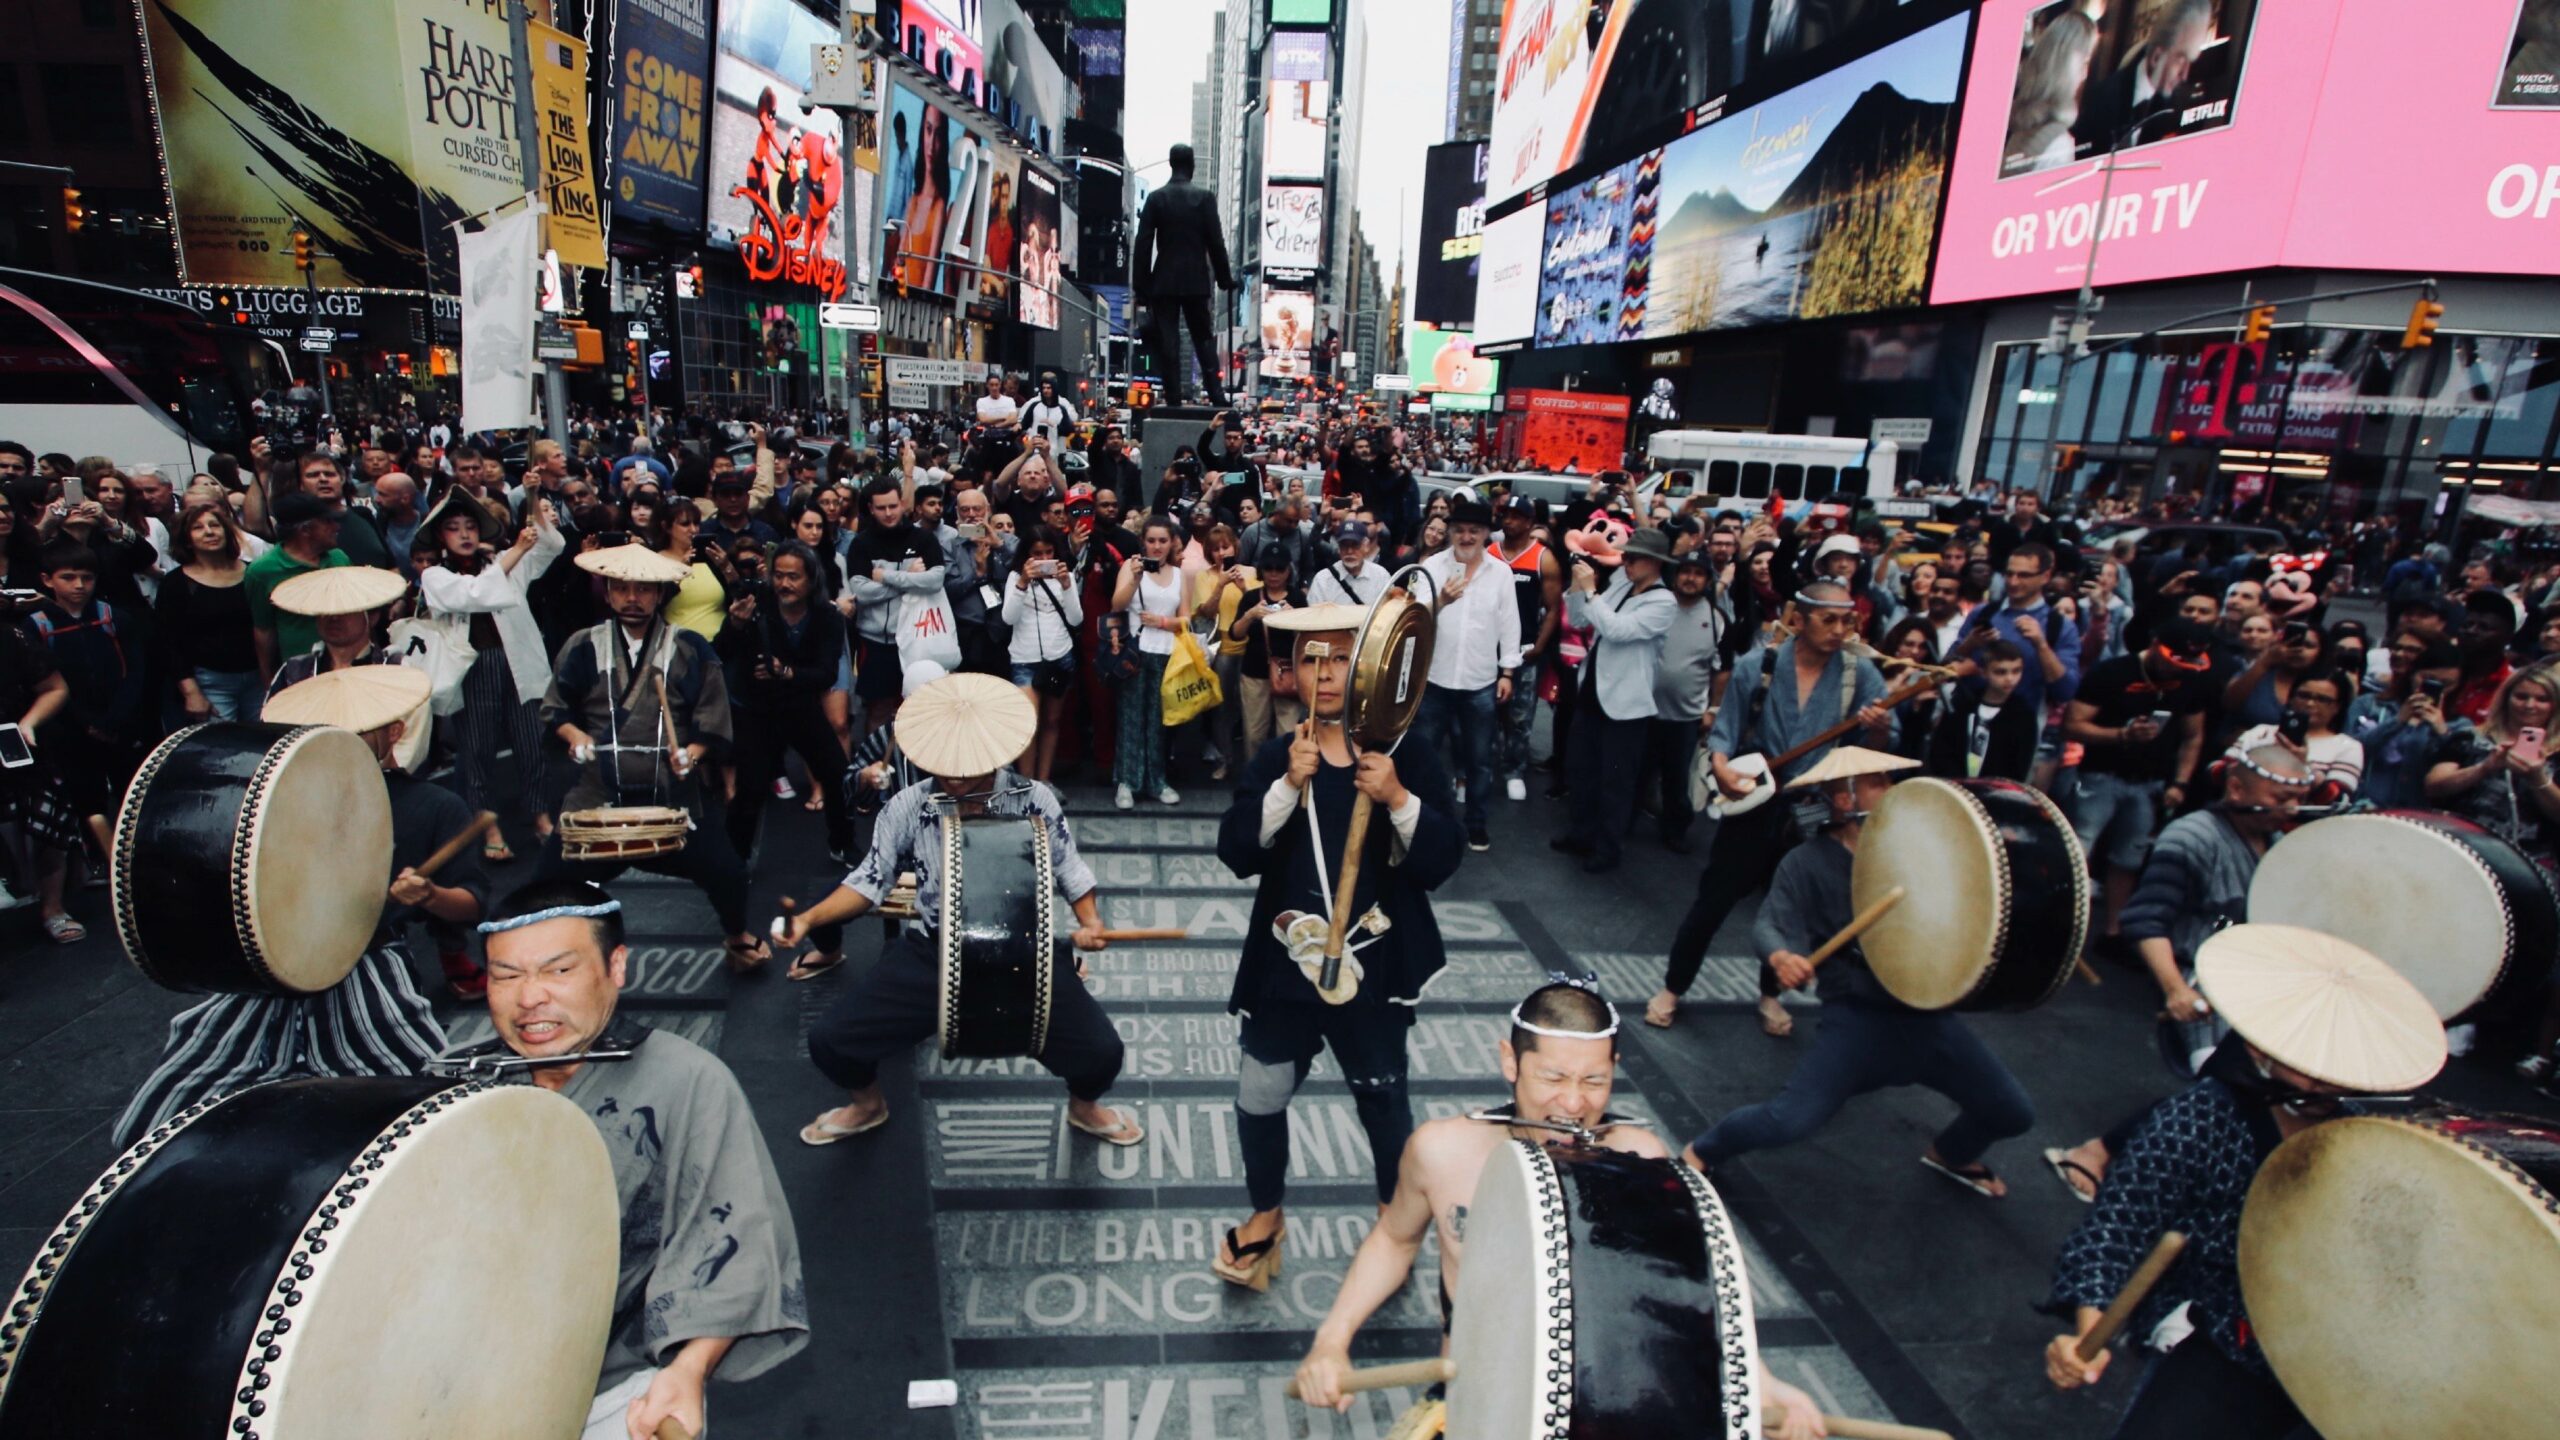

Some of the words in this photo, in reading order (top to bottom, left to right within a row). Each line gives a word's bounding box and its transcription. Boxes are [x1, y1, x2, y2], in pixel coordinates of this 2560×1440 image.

[424, 18, 516, 97] HARR
[625, 47, 703, 113] COME
[2512, 85, 2522, 93] A
[2523, 85, 2559, 94] SERIES
[2515, 74, 2554, 84] WATCH
[420, 67, 521, 141] POTT
[623, 83, 702, 148] FROM
[2180, 99, 2228, 127] NETFLIX
[548, 109, 576, 137] THE
[443, 138, 499, 167] CURSED
[475, 135, 494, 149] AND
[495, 139, 510, 153] THE
[547, 134, 584, 173] LION
[622, 126, 699, 181] AWAY
[459, 164, 481, 177] PARTS
[482, 169, 497, 182] ONE
[548, 171, 595, 217] KING
[942, 136, 994, 267] 21
[261, 217, 287, 225] STREET
[1992, 213, 2039, 259] OR
[2045, 192, 2143, 251] YOUR
[2151, 179, 2209, 234] TV
[139, 288, 214, 311] IFTS
[234, 290, 363, 317] LUGGAGE
[257, 327, 293, 338] SONY
[939, 374, 960, 383] MOVING
[945, 365, 960, 373] ZONE
[2283, 424, 2339, 439] CHARGE
[957, 1210, 1082, 1264] ETHEL
